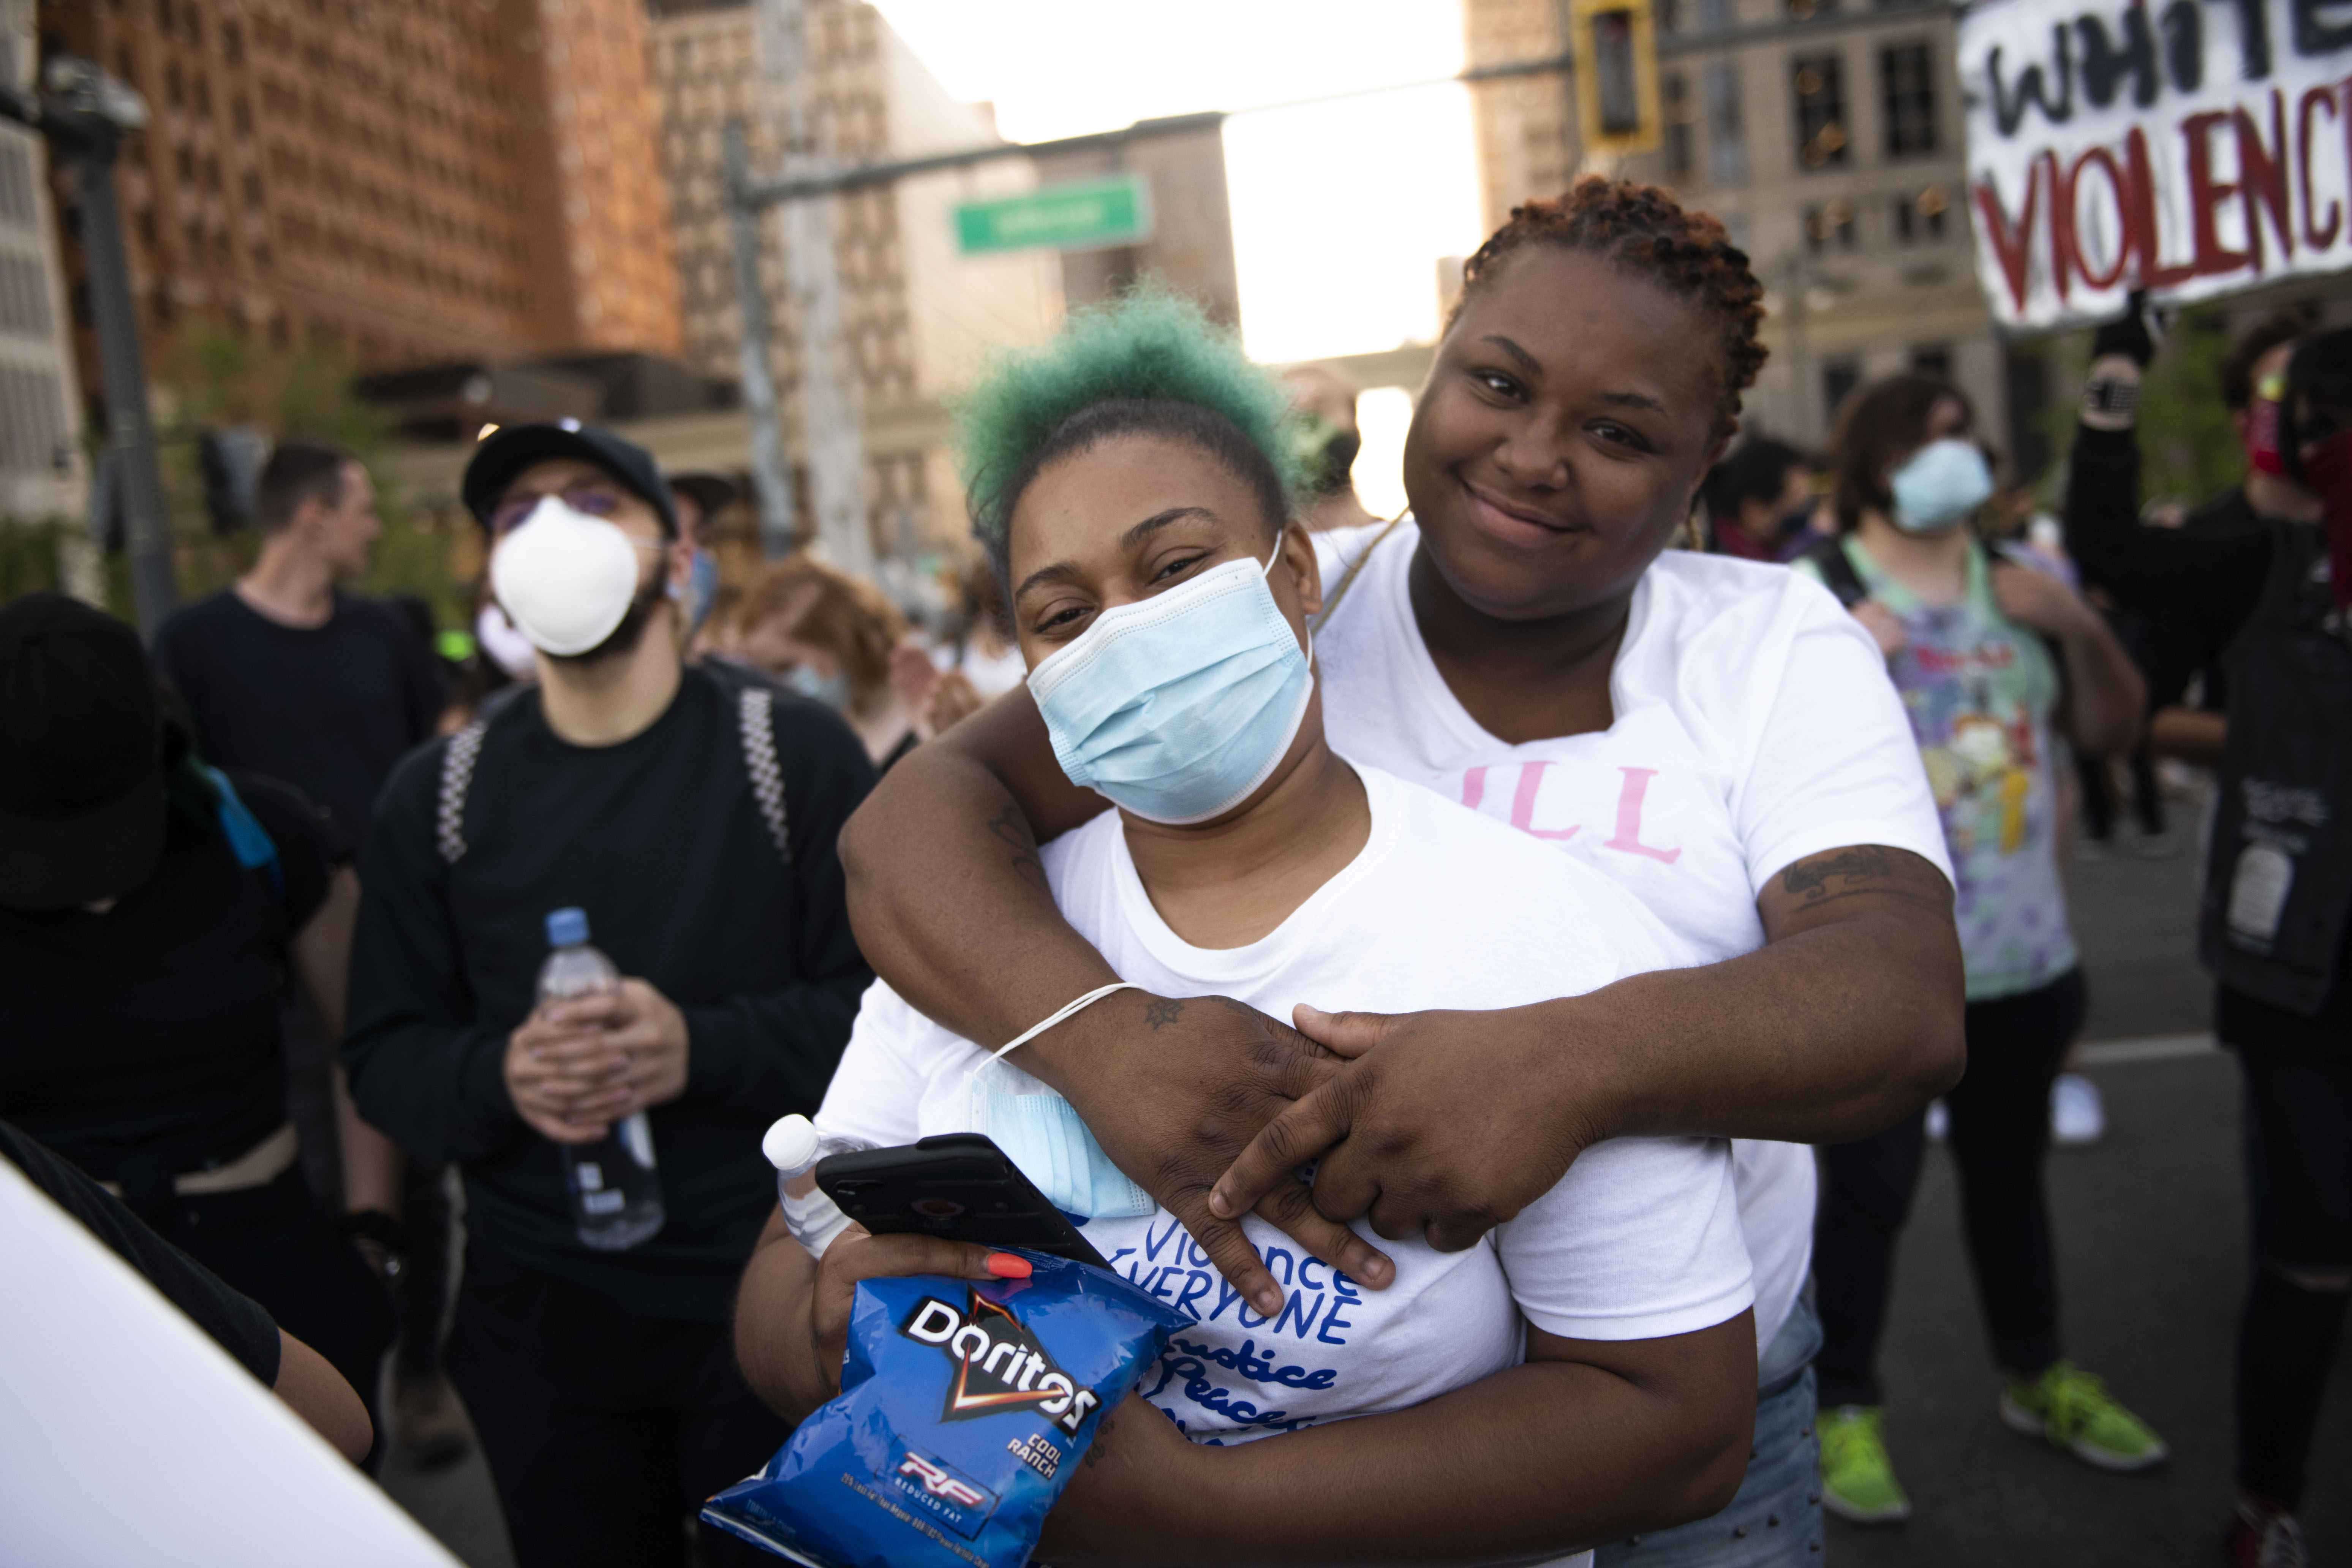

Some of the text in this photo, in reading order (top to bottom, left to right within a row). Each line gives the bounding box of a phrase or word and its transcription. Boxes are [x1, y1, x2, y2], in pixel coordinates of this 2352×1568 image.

[1975, 72, 2352, 315] VIOLENC
[1146, 1218, 1361, 1296] Vionce
[908, 1299, 1098, 1430] Doritos
[1171, 1339, 1337, 1391] ustice
[1007, 1438, 1057, 1479] RANCH
[1027, 1432, 1062, 1465] COOL
[894, 1477, 962, 1523] REDUCED FAT
